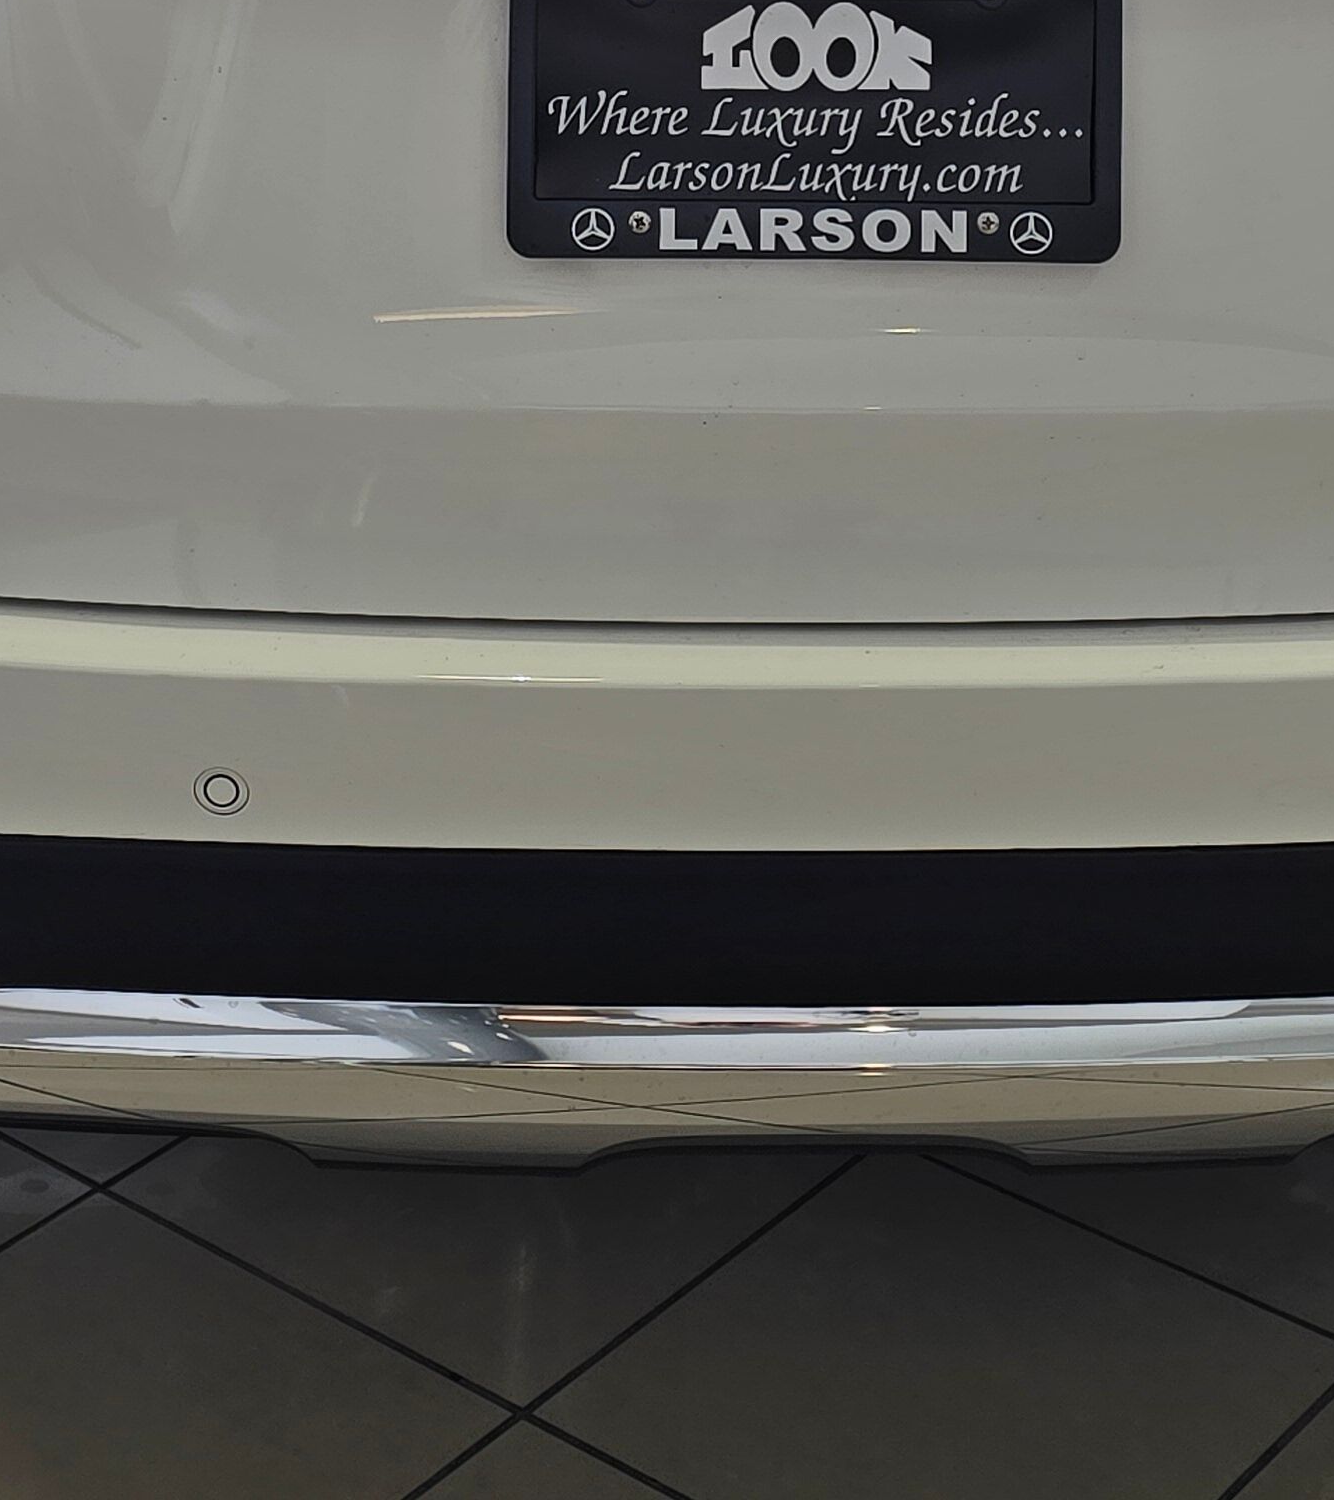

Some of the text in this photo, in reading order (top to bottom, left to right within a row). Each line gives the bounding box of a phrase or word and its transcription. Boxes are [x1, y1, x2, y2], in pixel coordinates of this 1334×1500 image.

[547, 90, 1085, 154] Where Luxury Resides...
[609, 152, 1025, 202] LarsonLuxury.com
[659, 208, 967, 254] LARSON
